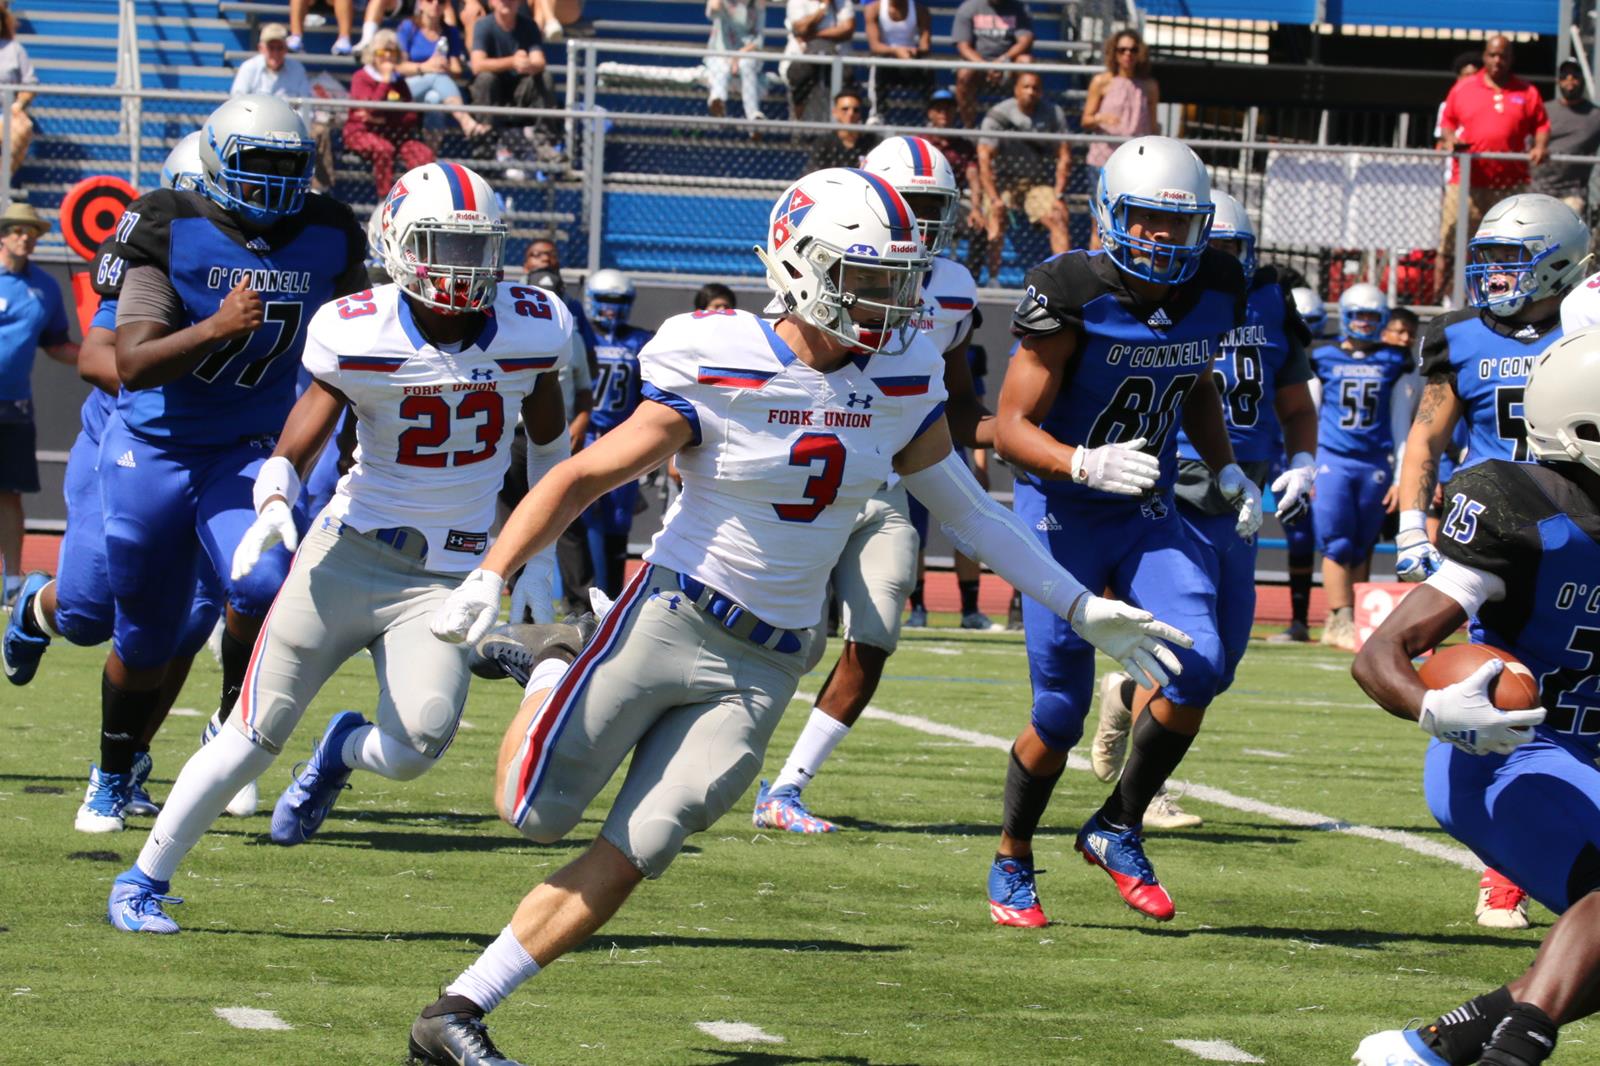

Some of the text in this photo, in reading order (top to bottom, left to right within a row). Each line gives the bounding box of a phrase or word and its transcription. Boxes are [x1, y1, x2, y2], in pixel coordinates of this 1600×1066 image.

[890, 244, 917, 253] Riddell
[97, 253, 124, 286] 64
[1106, 340, 1210, 368] O'CONNELL
[404, 381, 498, 395] FORK UNION
[592, 362, 632, 411] 73
[1339, 378, 1381, 430] 55
[396, 391, 505, 468] 23
[767, 409, 873, 428] FORK UNION
[771, 431, 847, 524] 3
[1442, 493, 1486, 544] 25
